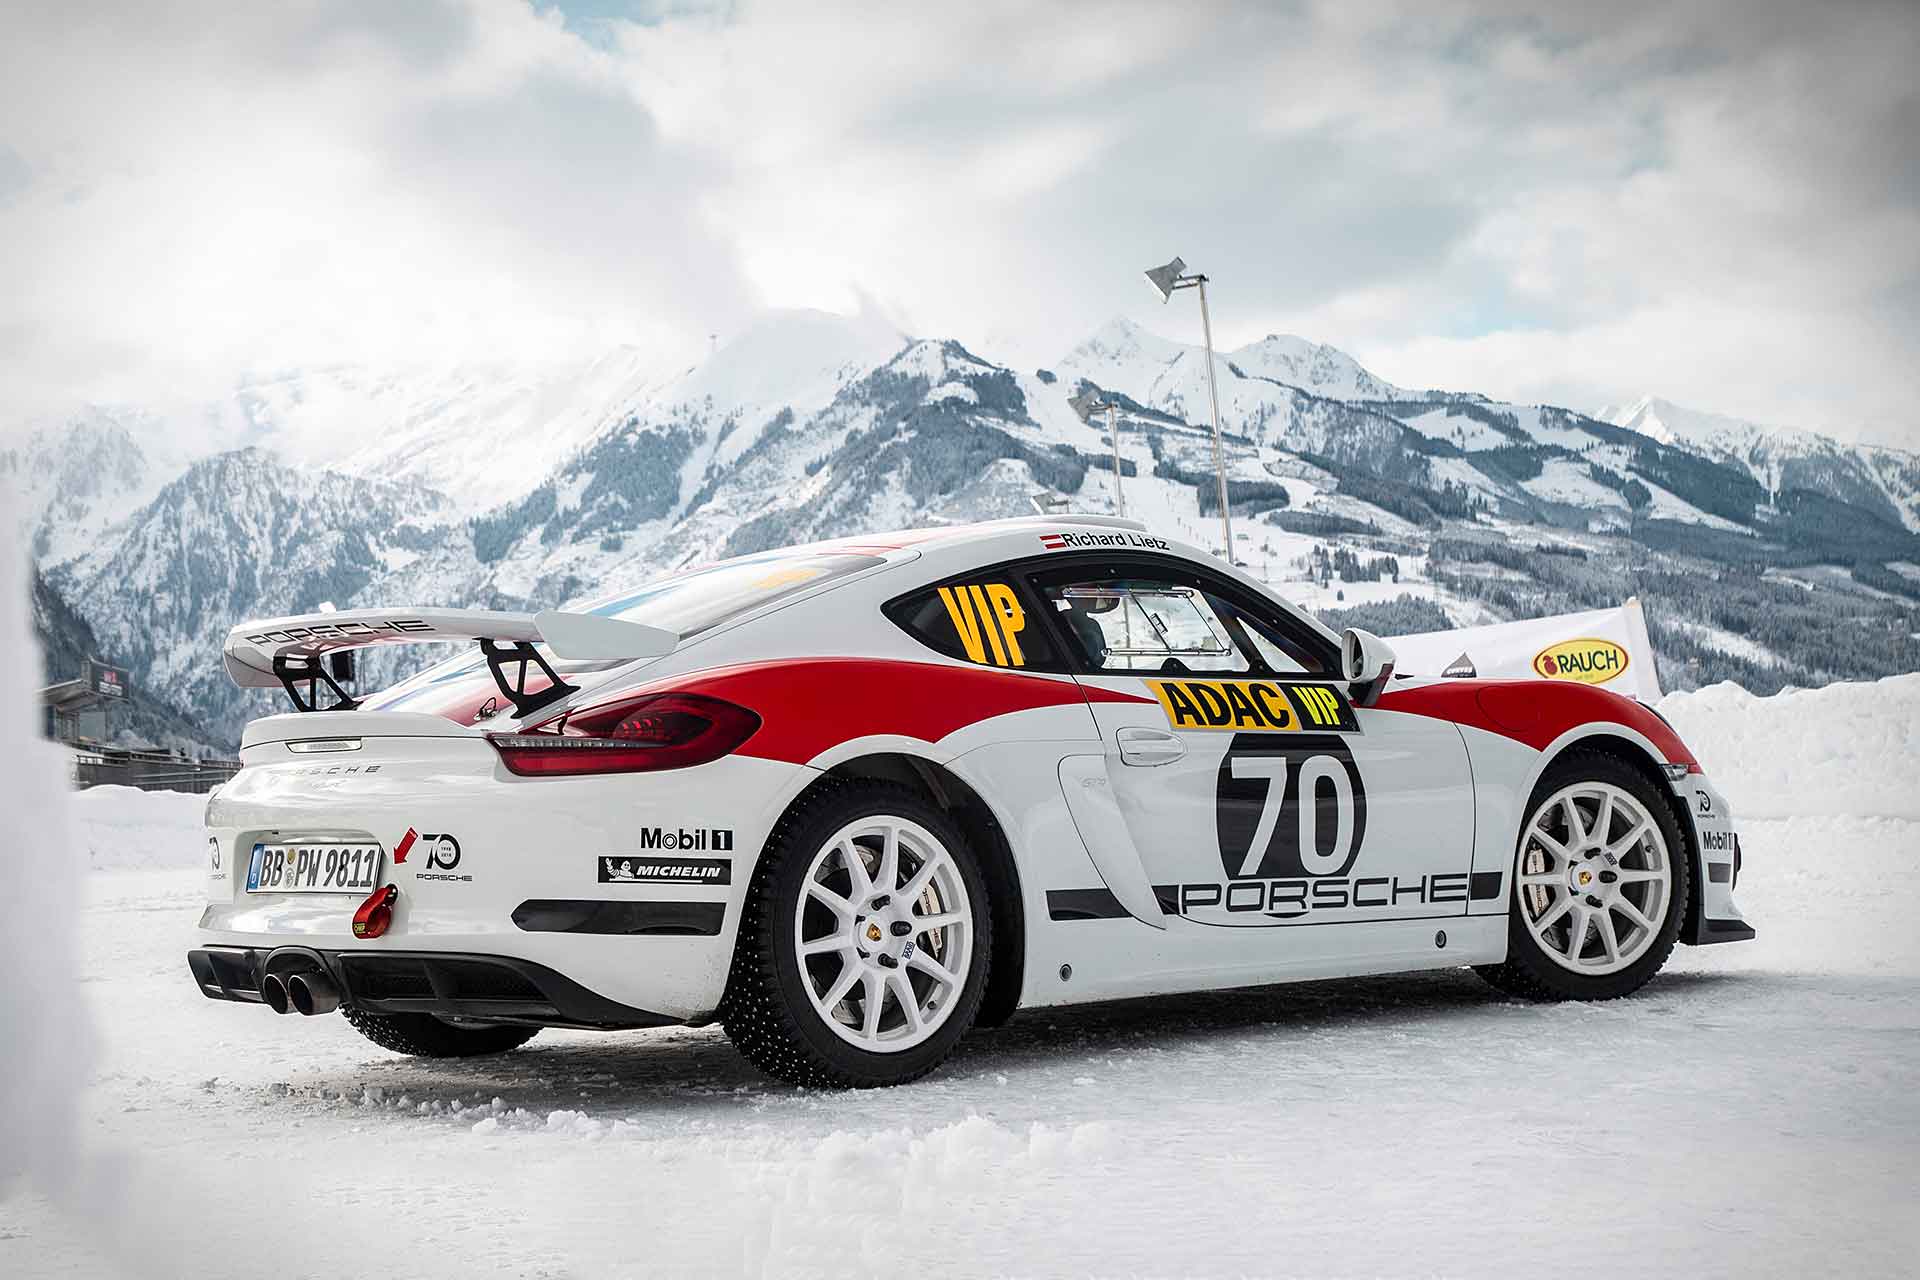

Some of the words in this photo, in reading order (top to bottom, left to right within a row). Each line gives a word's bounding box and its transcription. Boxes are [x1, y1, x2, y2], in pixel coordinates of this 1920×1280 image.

[1060, 531, 1127, 547] Richard
[1128, 533, 1170, 551] Lietz
[244, 619, 436, 647] PORSCHE
[938, 583, 1026, 667] VIP
[1556, 648, 1619, 674] RAUCH
[1160, 682, 1290, 729] ADAC
[1292, 686, 1341, 726] VIP
[1231, 754, 1355, 877] 70
[422, 833, 461, 870] 70
[640, 827, 706, 850] Mobil
[715, 830, 728, 850] 1
[1703, 831, 1727, 850] Mobil
[260, 849, 285, 887] BB
[294, 849, 322, 887] PW
[323, 849, 376, 887] 9811
[416, 873, 472, 881] PORSCHE
[636, 865, 720, 878] MICHELIN
[1180, 871, 1469, 914] PORSCHE
